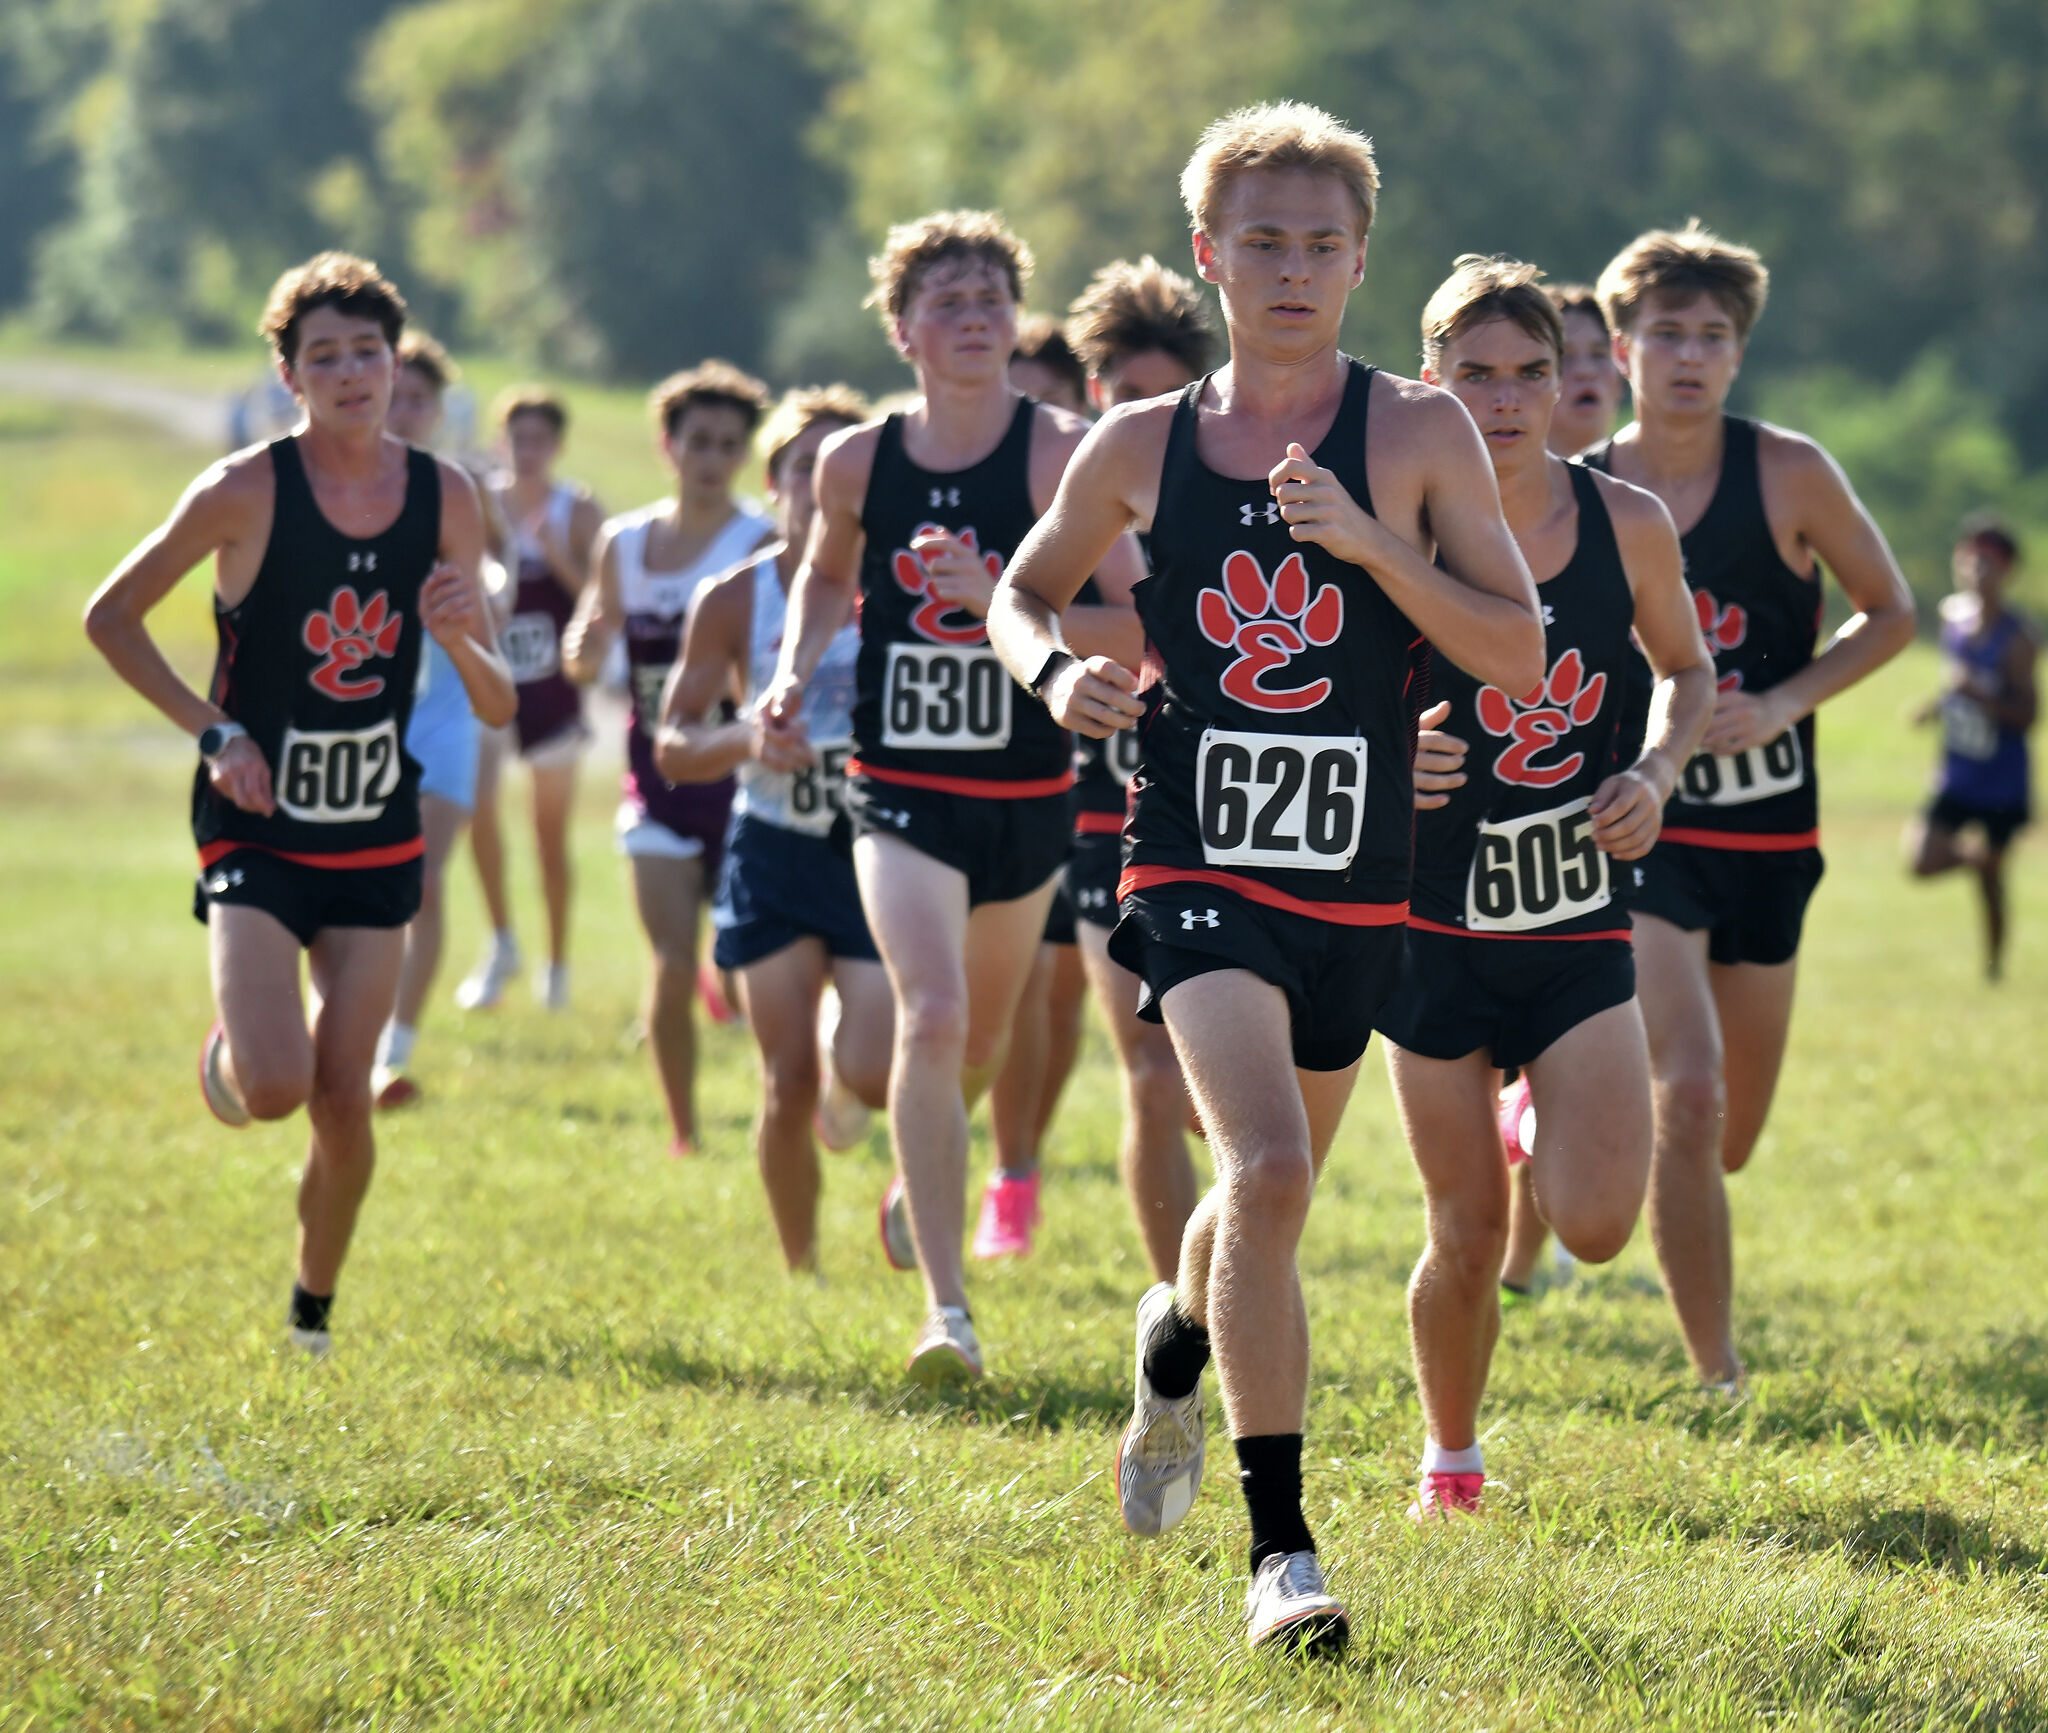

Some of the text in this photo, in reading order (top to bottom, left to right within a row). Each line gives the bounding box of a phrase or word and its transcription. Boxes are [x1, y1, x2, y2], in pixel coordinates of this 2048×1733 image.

[891, 654, 1001, 737] 630
[286, 734, 392, 810] 602
[1202, 743, 1357, 855] 626
[1475, 809, 1602, 918] 605
